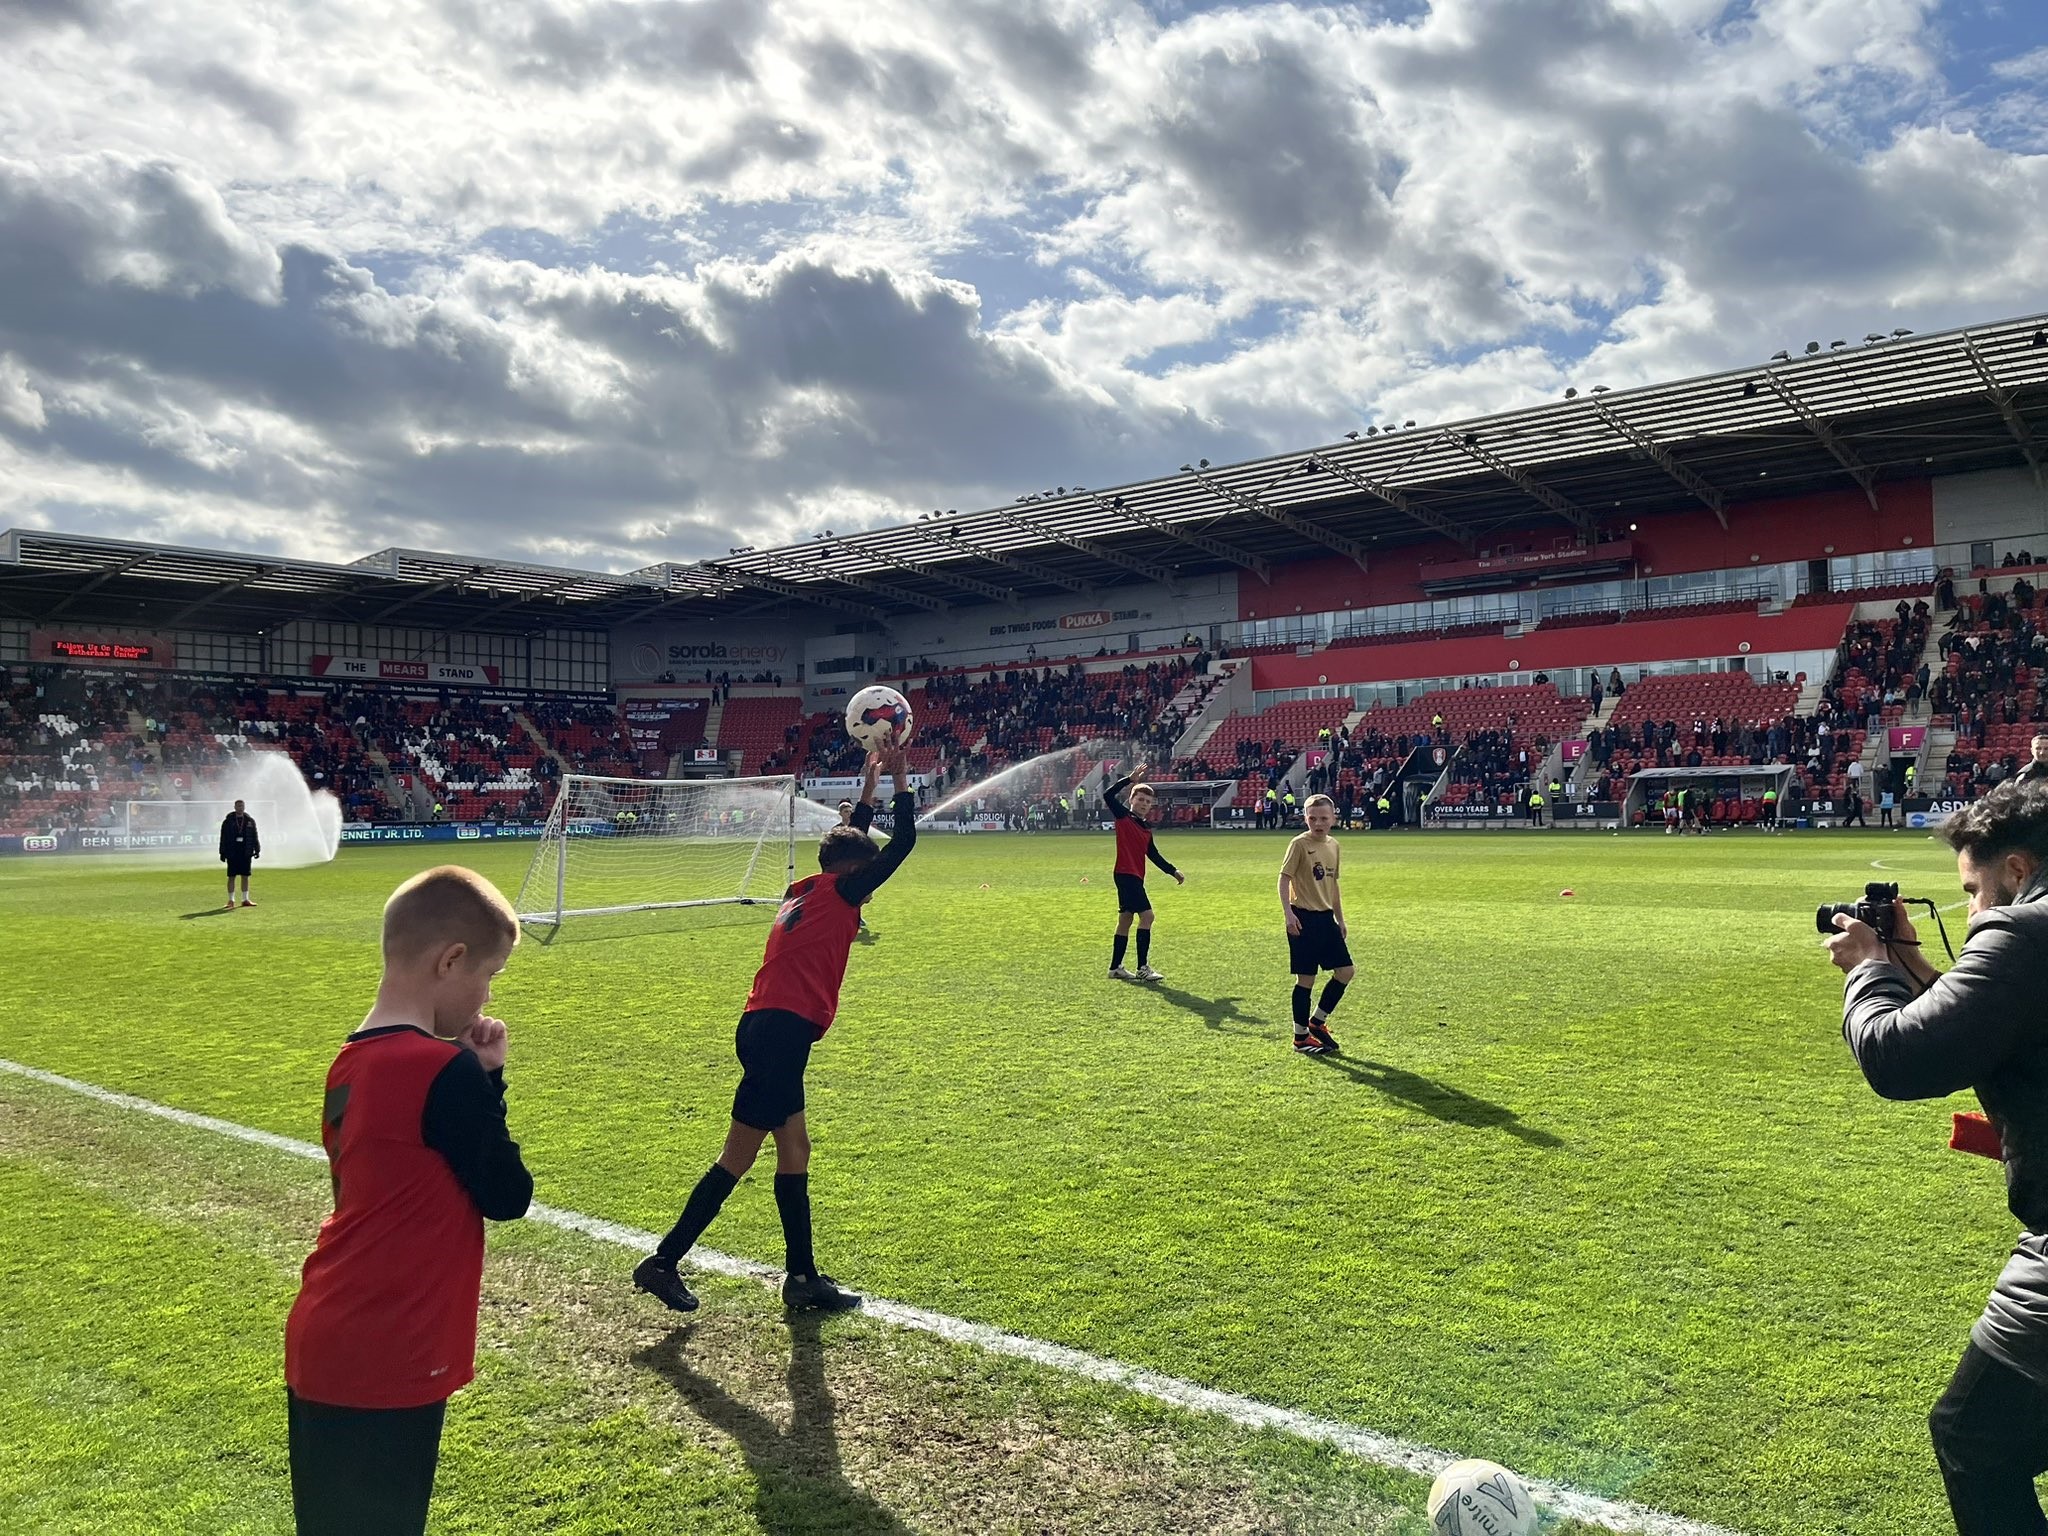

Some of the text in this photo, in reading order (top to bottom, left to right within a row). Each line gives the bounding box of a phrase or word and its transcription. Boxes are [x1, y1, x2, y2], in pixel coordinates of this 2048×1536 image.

[1557, 549, 1587, 558] Stadium
[990, 625, 1006, 635] ERIC
[1032, 619, 1057, 631] FOODS
[1066, 612, 1103, 628] PUKKA
[57, 641, 148, 654] Follow Us On Facebook
[668, 641, 788, 662] sorola energy
[68, 649, 138, 658] Rotherham United
[344, 661, 474, 679] THE MEARS STAND
[1903, 733, 1911, 745] F
[1572, 746, 1580, 756] E
[175, 778, 183, 787] C
[1434, 805, 1489, 813] OVER 40 YEARS
[341, 829, 425, 840] ENNETT JR. LTD.
[460, 828, 477, 836] BB
[497, 827, 516, 836] BEN
[576, 825, 594, 834] LTD.
[29, 839, 52, 850] BB
[82, 837, 110, 847] BEN
[113, 836, 174, 847] BENNETT
[1461, 1494, 1499, 1536] mitre
